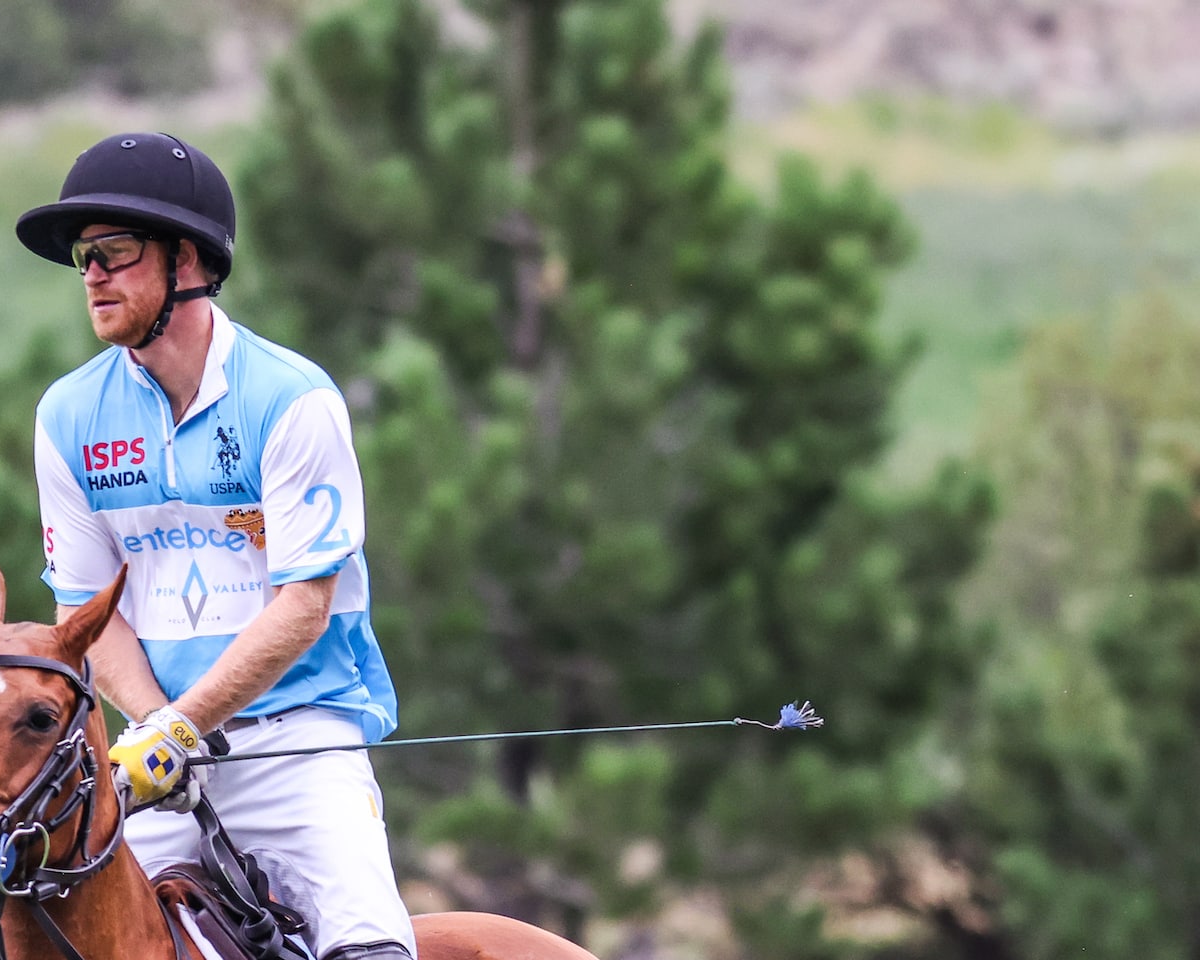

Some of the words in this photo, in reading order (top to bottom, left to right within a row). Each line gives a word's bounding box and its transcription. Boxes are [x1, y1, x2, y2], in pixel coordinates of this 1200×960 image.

[83, 437, 145, 471] ISPS
[87, 470, 148, 491] HANDA
[209, 482, 246, 495] USPA
[304, 484, 351, 553] 2
[213, 581, 263, 593] VALLEY
